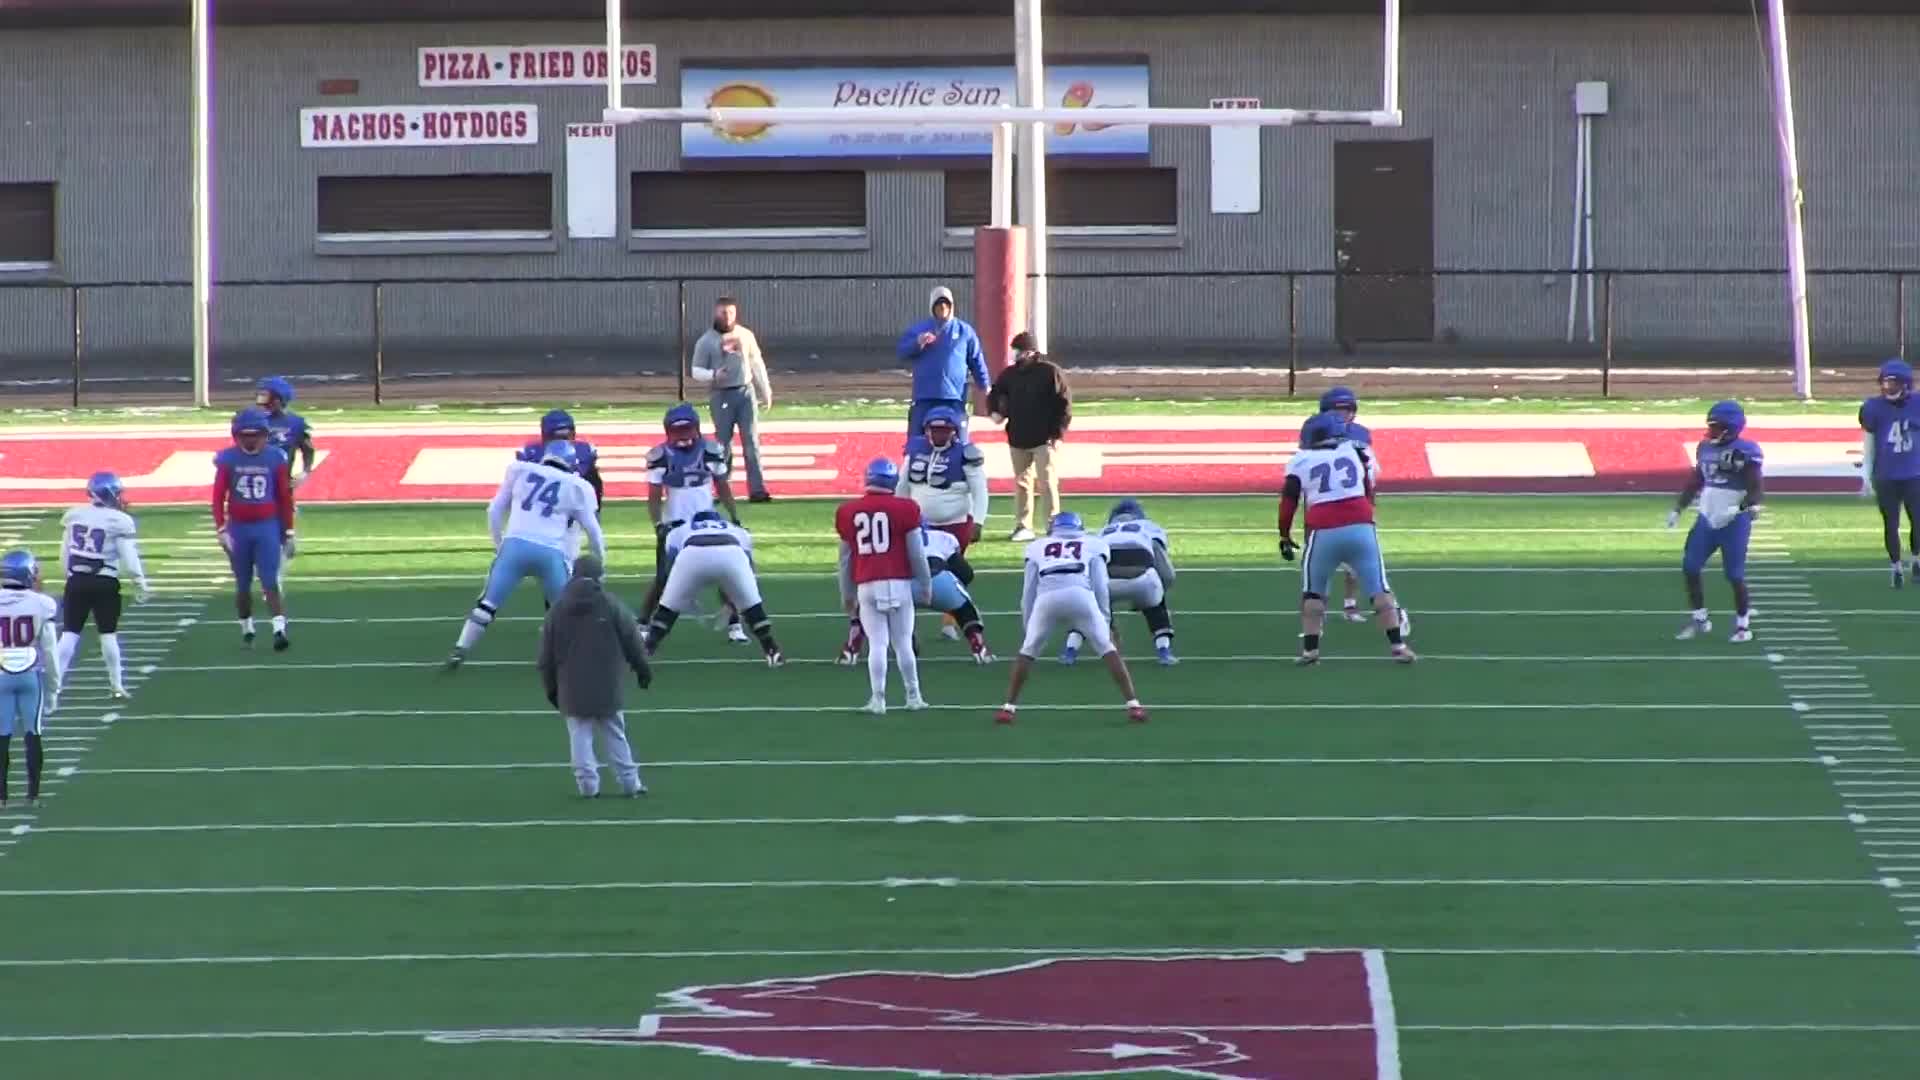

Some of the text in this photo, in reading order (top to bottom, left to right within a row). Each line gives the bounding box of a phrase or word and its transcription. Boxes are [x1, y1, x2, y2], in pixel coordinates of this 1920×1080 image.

[424, 50, 651, 80] PIZZA FRIED OROS
[833, 80, 1001, 108] Pacific Sun
[312, 111, 527, 140] NACHOS HOTDOGS
[568, 126, 613, 137] MENU
[1310, 457, 1358, 493] 73
[521, 472, 561, 517] 74
[853, 511, 890, 555] 20
